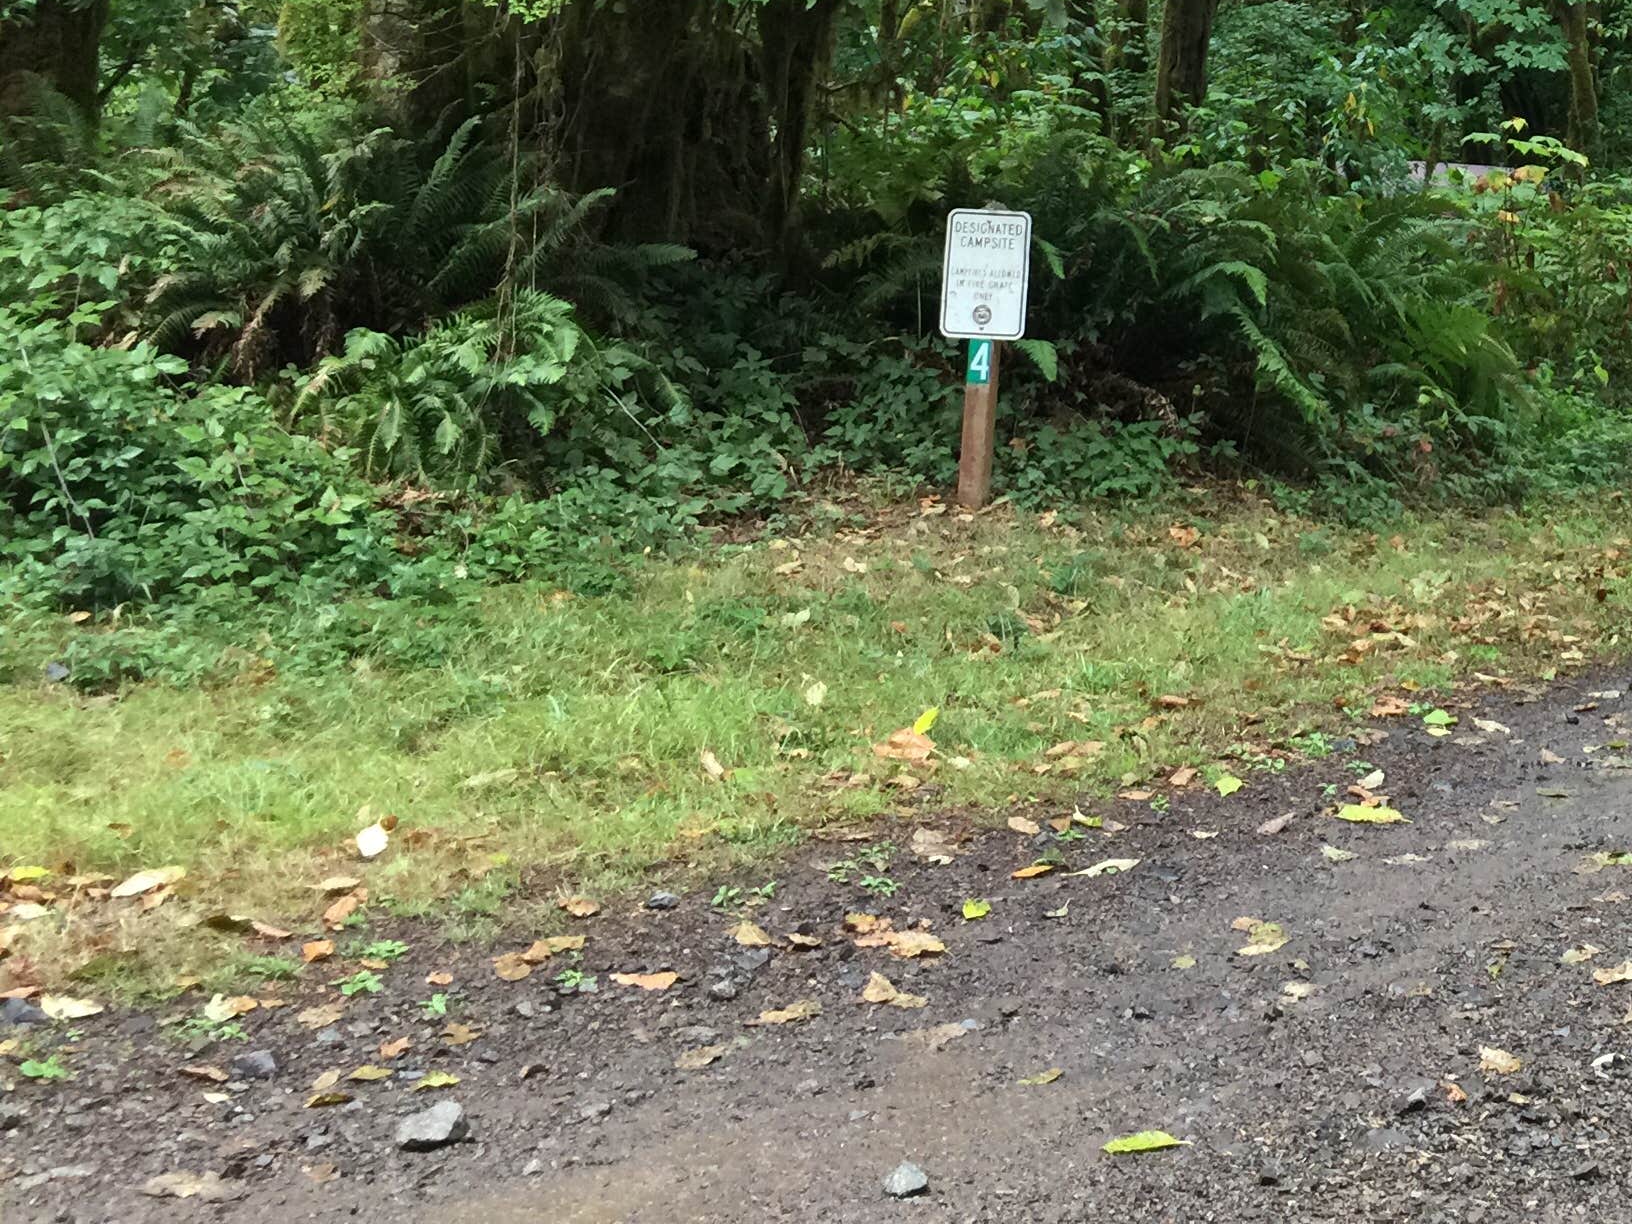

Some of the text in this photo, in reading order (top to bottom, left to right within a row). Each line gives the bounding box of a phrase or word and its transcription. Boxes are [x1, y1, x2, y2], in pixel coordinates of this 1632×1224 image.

[955, 221, 1023, 236] DESIGNATED
[960, 236, 1015, 249] CAMPSITE
[970, 342, 989, 380] 4
